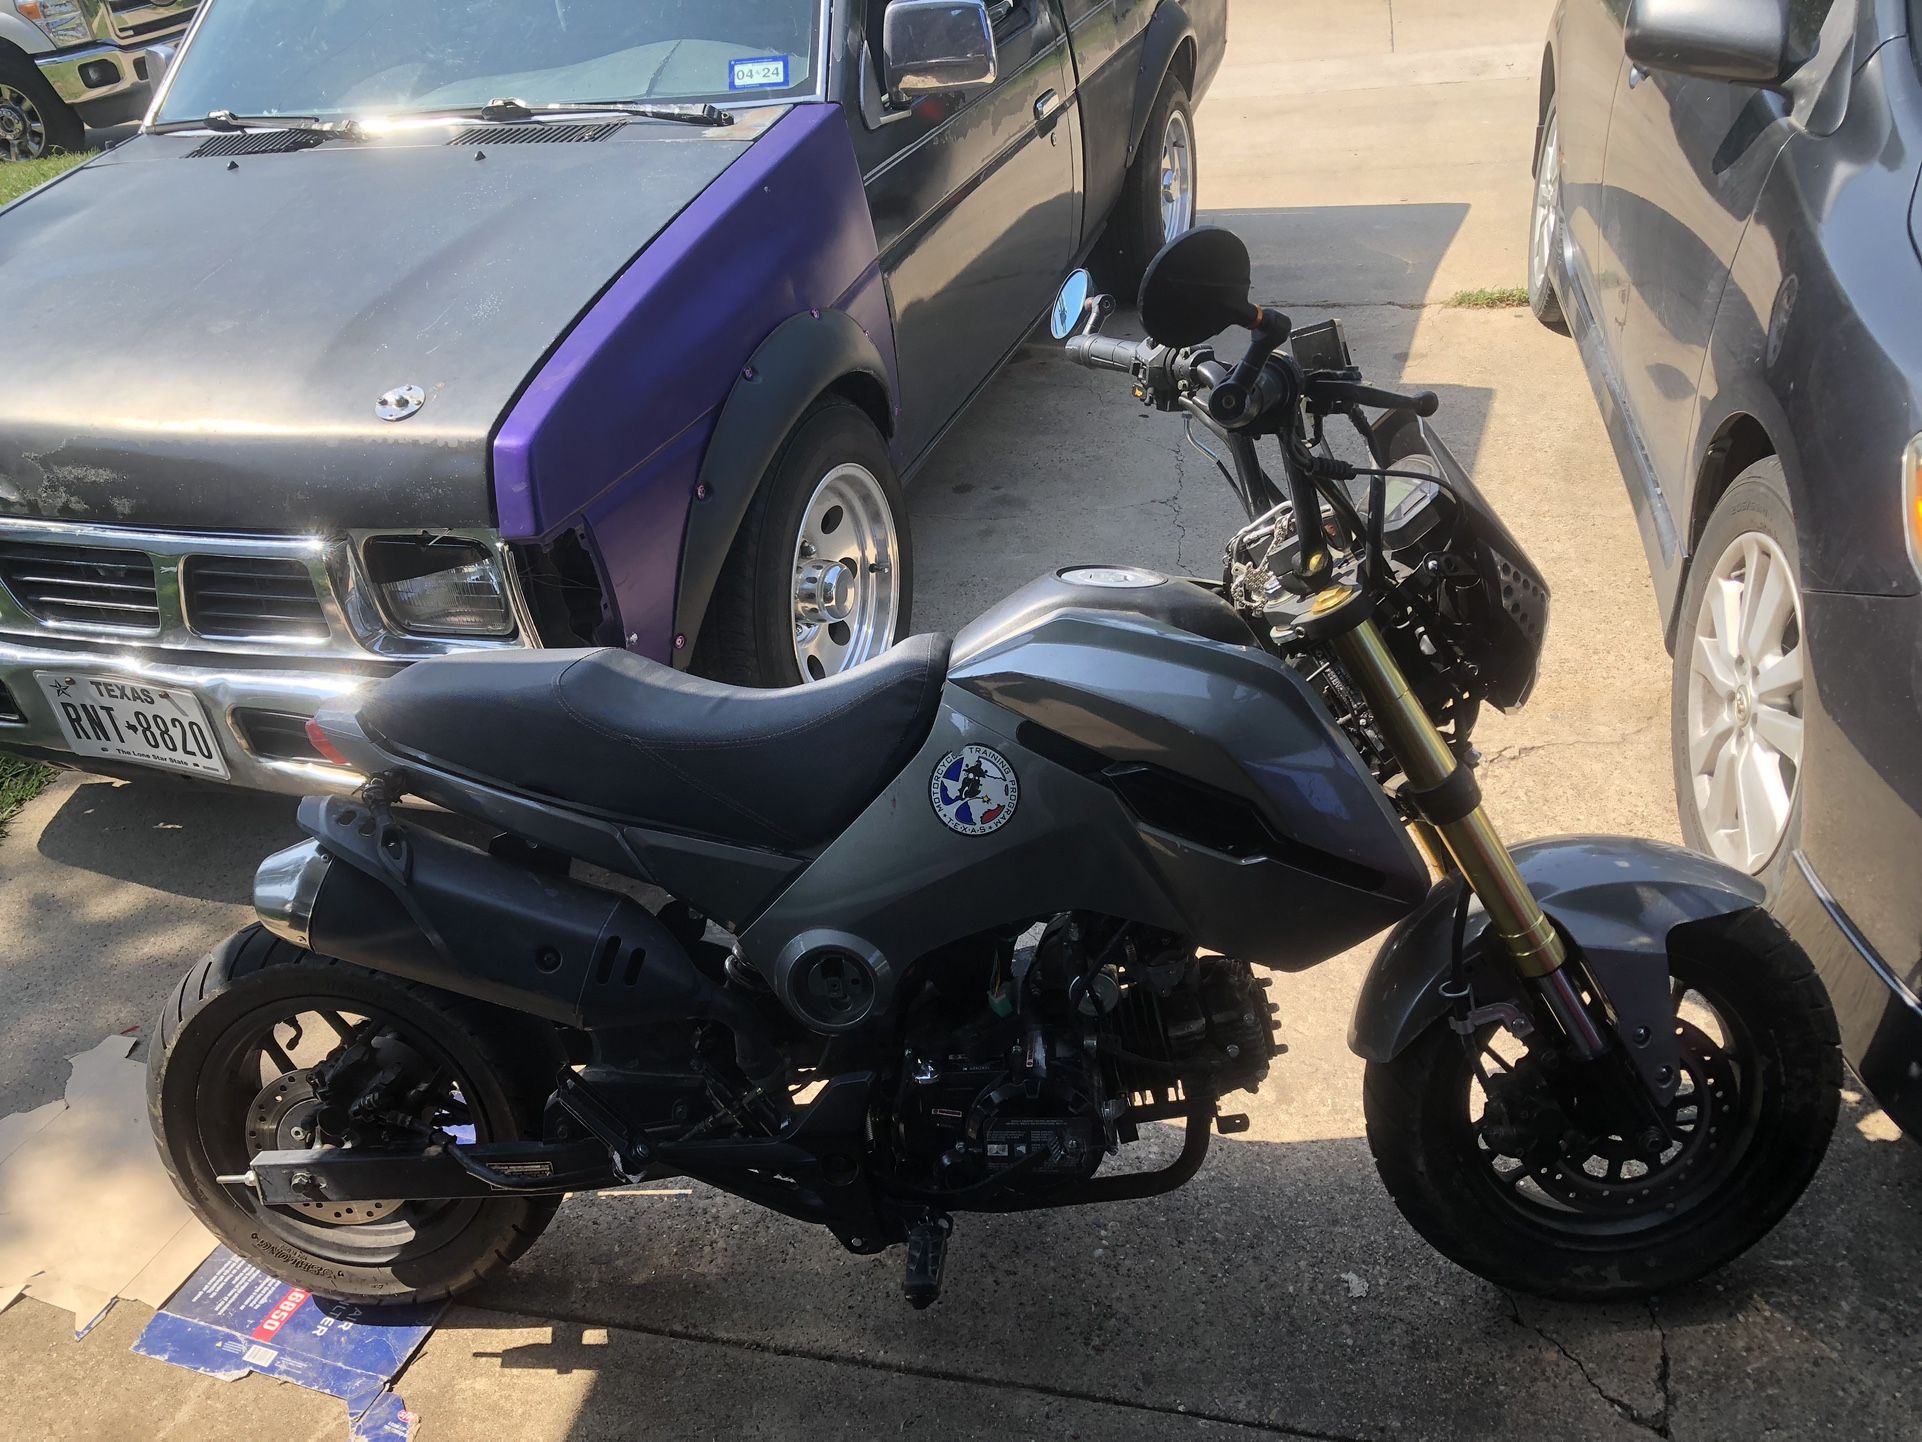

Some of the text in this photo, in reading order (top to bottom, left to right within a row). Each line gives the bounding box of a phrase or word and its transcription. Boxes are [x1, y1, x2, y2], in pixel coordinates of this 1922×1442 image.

[736, 67, 780, 81] 04 24
[90, 681, 155, 705] TEXAS
[60, 702, 214, 760] RNT 8820
[116, 748, 189, 766] The Lone Star State
[932, 747, 1017, 828] MOTORCYCL TRAINING PROGRAM
[263, 1287, 306, 1331] 6850
[312, 1301, 350, 1337] ILTER
[337, 1307, 363, 1331] AIR
